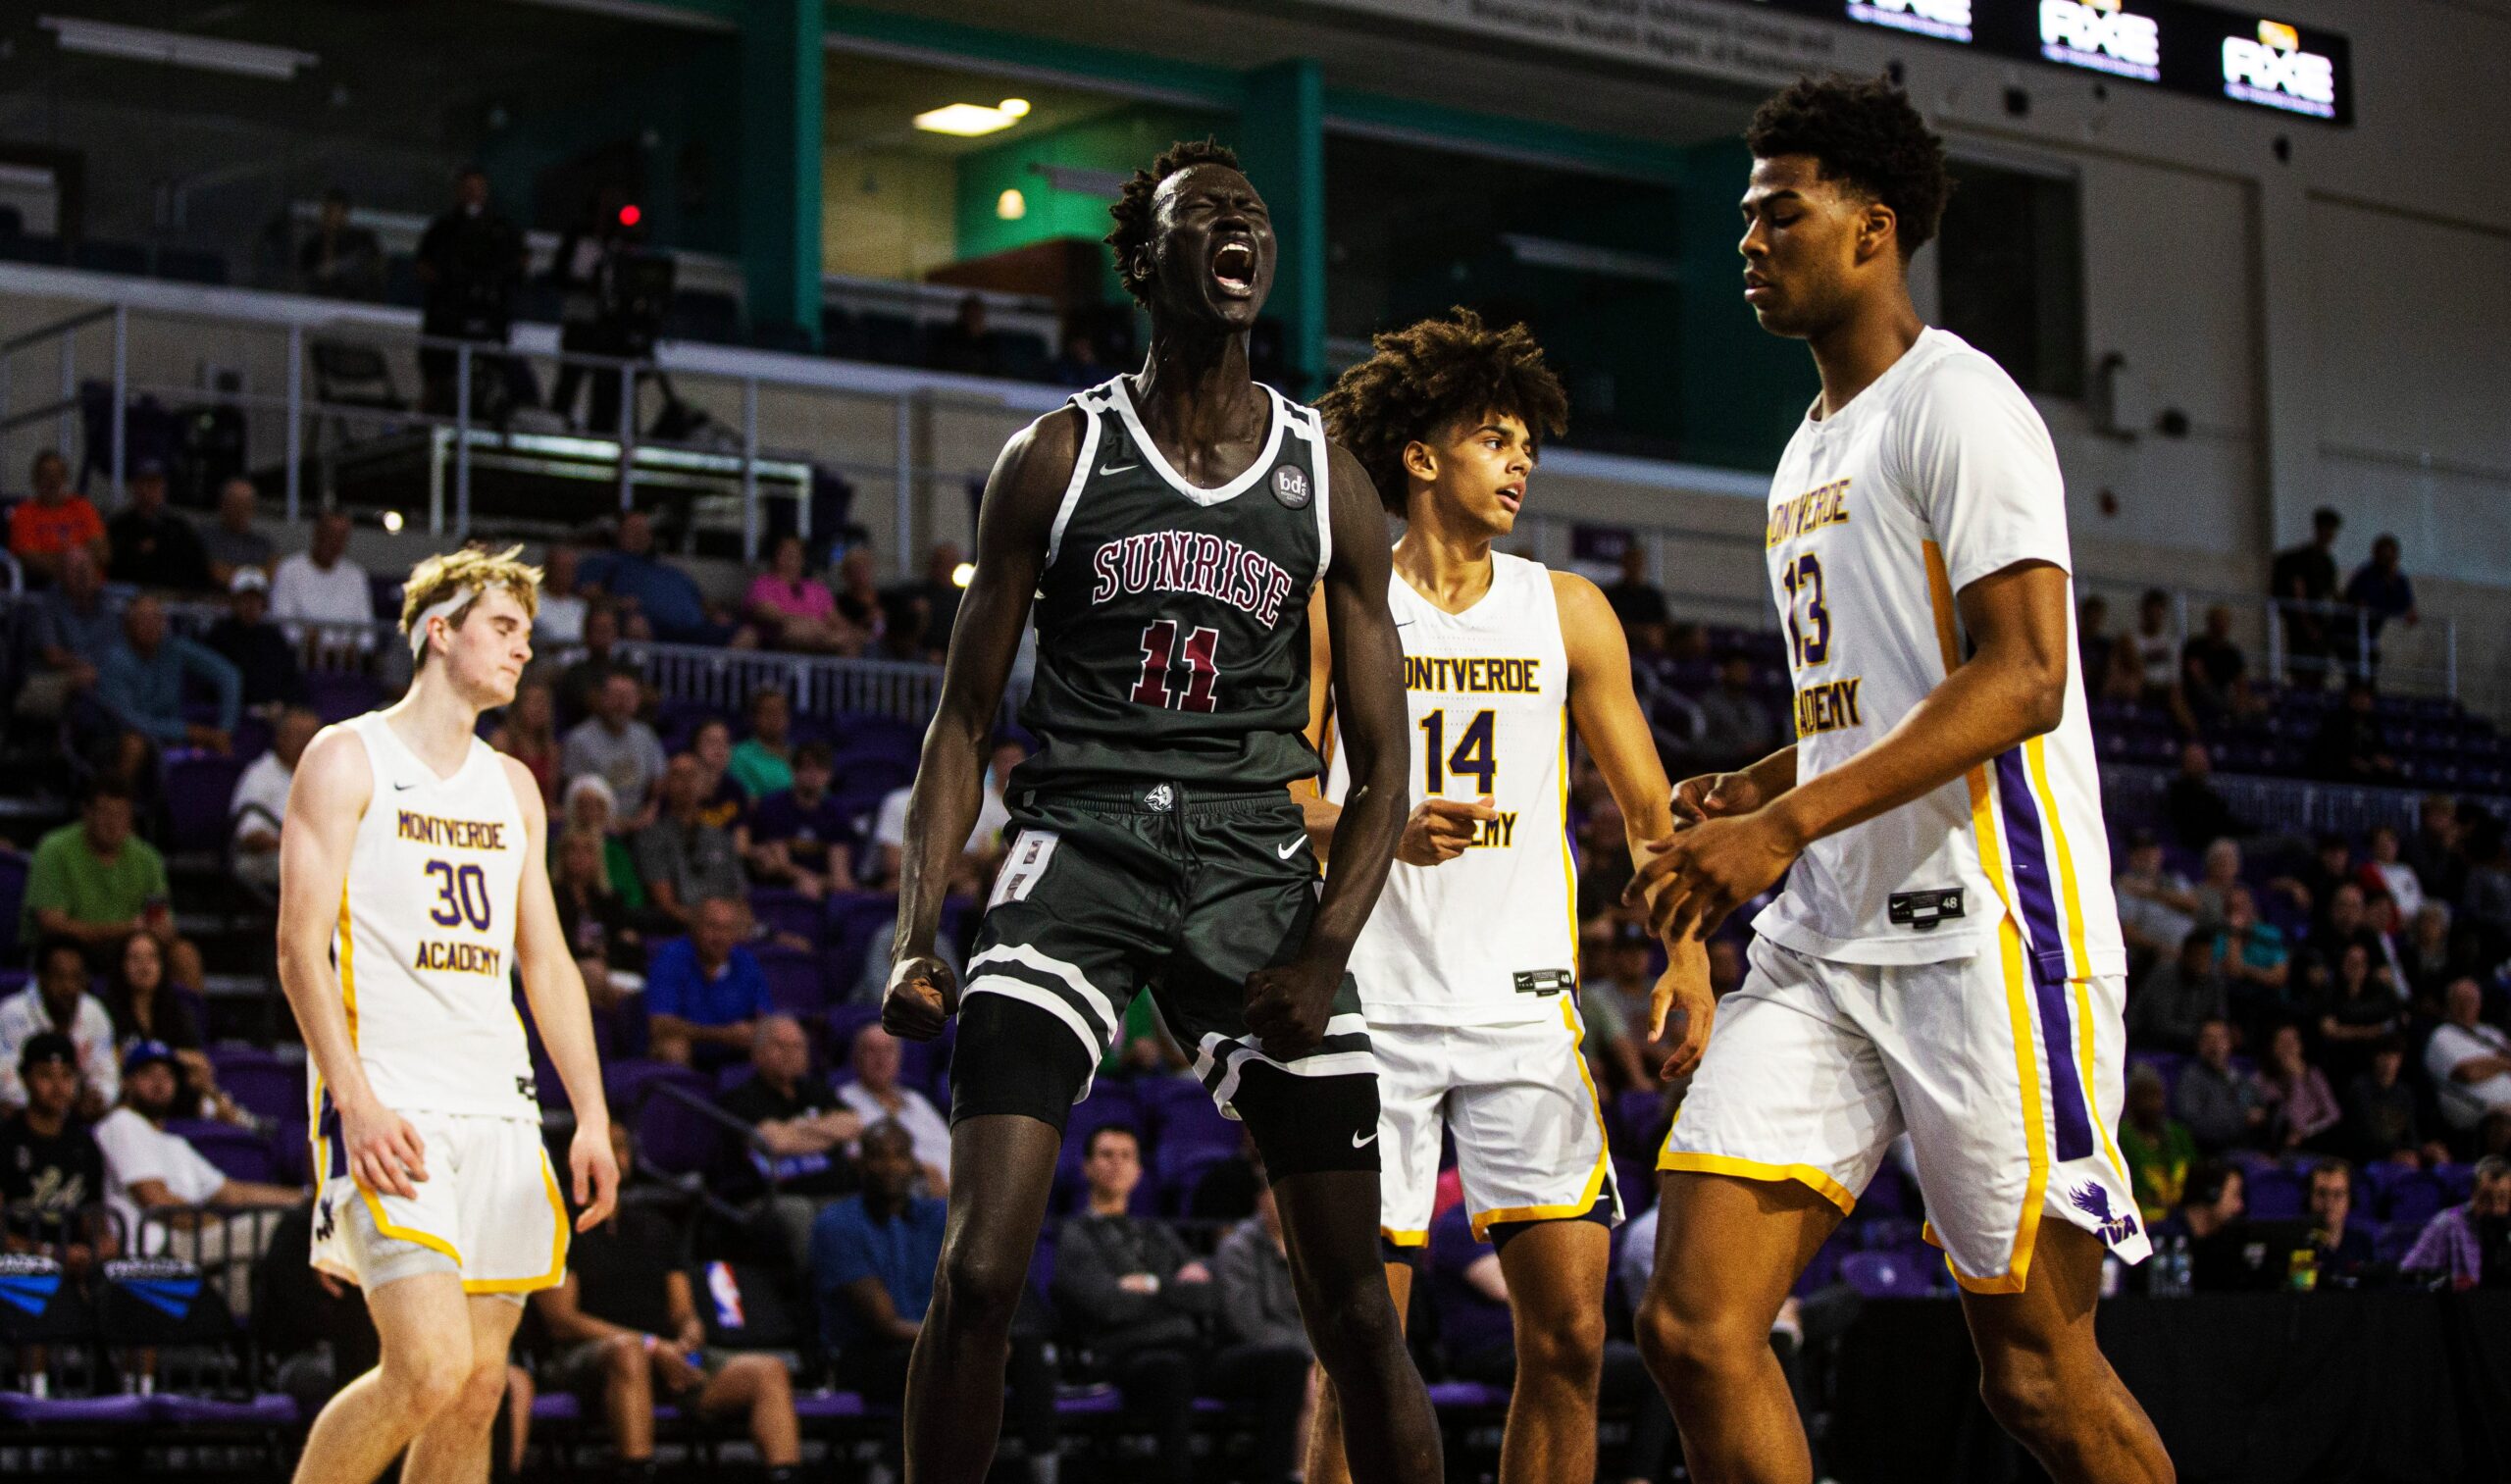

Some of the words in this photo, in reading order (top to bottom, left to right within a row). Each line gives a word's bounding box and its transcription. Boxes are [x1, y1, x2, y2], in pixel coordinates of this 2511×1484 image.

[2039, 0, 2159, 67] AXE
[2223, 36, 2334, 104] AXE
[1767, 478, 1851, 548] ONTVERDE
[1092, 530, 1293, 631] SUNRISE
[1783, 549, 1831, 672] 13
[1130, 619, 1221, 714] 11
[1404, 656, 1541, 694] ONTVERDE
[1794, 676, 1862, 739] ADEMY
[1418, 707, 1498, 796] 14
[397, 809, 507, 851] MONTVERDE
[424, 858, 491, 933] 30
[1942, 896, 1958, 909] 48
[414, 940, 501, 979] ACADEMY
